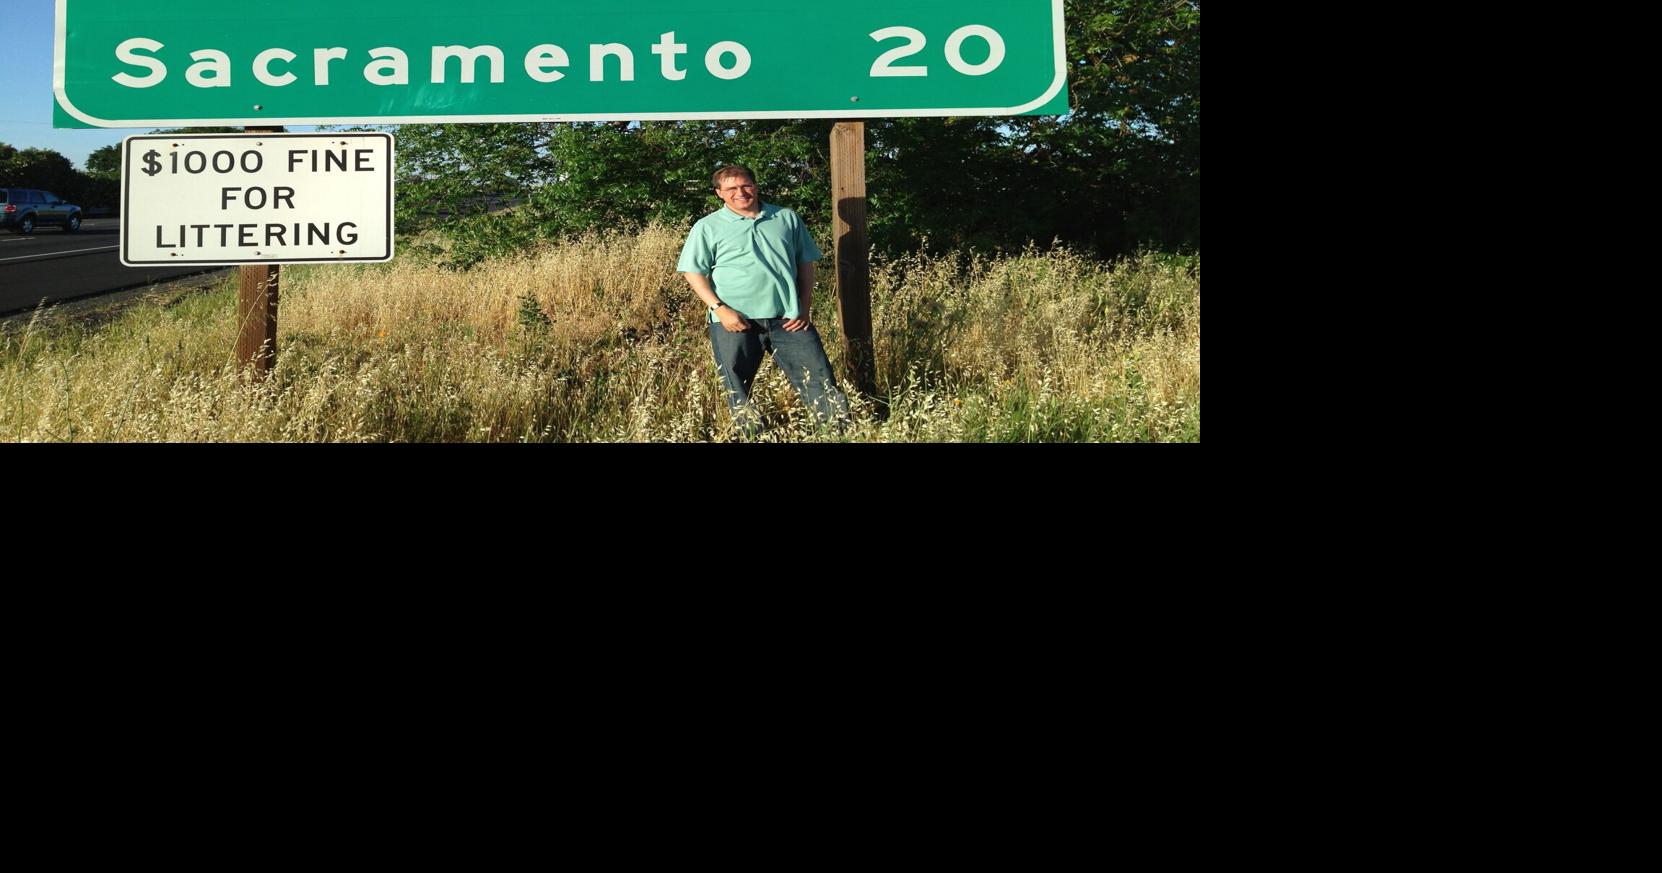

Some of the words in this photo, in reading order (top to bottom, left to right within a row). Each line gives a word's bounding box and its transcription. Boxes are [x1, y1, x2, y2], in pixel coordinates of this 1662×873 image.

[111, 31, 753, 89] Sacramento
[869, 24, 1006, 78] 20
[141, 149, 263, 177] $1000
[288, 149, 375, 173] FINE
[221, 186, 295, 210] FOR
[156, 221, 359, 249] LITTERING
